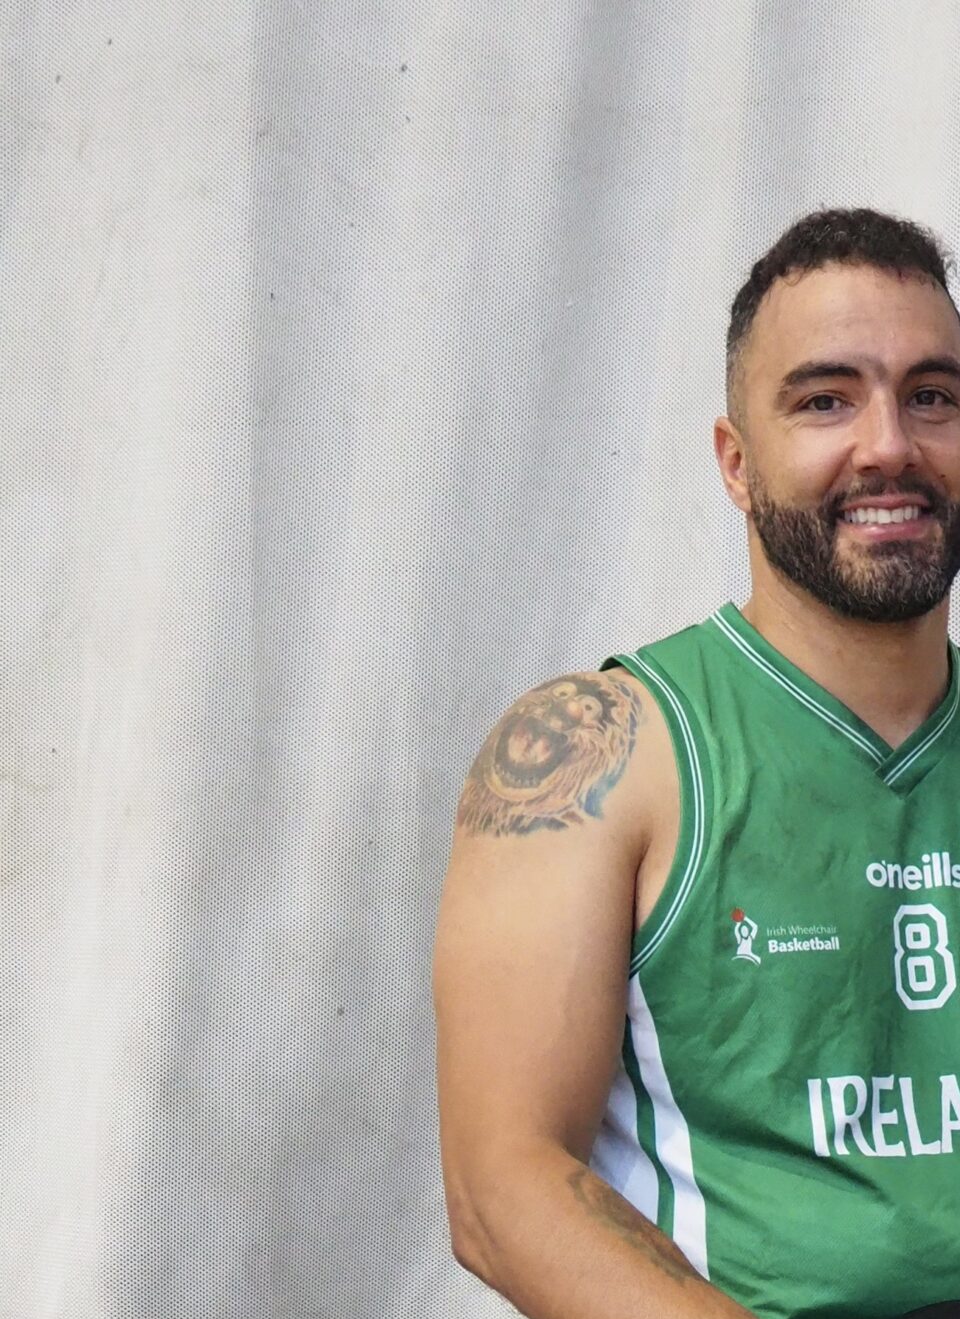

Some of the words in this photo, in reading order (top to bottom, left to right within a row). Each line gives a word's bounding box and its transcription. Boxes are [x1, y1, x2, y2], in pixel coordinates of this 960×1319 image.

[766, 925, 787, 937] Irish
[787, 923, 837, 935] Wheelchair
[768, 936, 840, 953] Basketball
[894, 903, 957, 1011] 8
